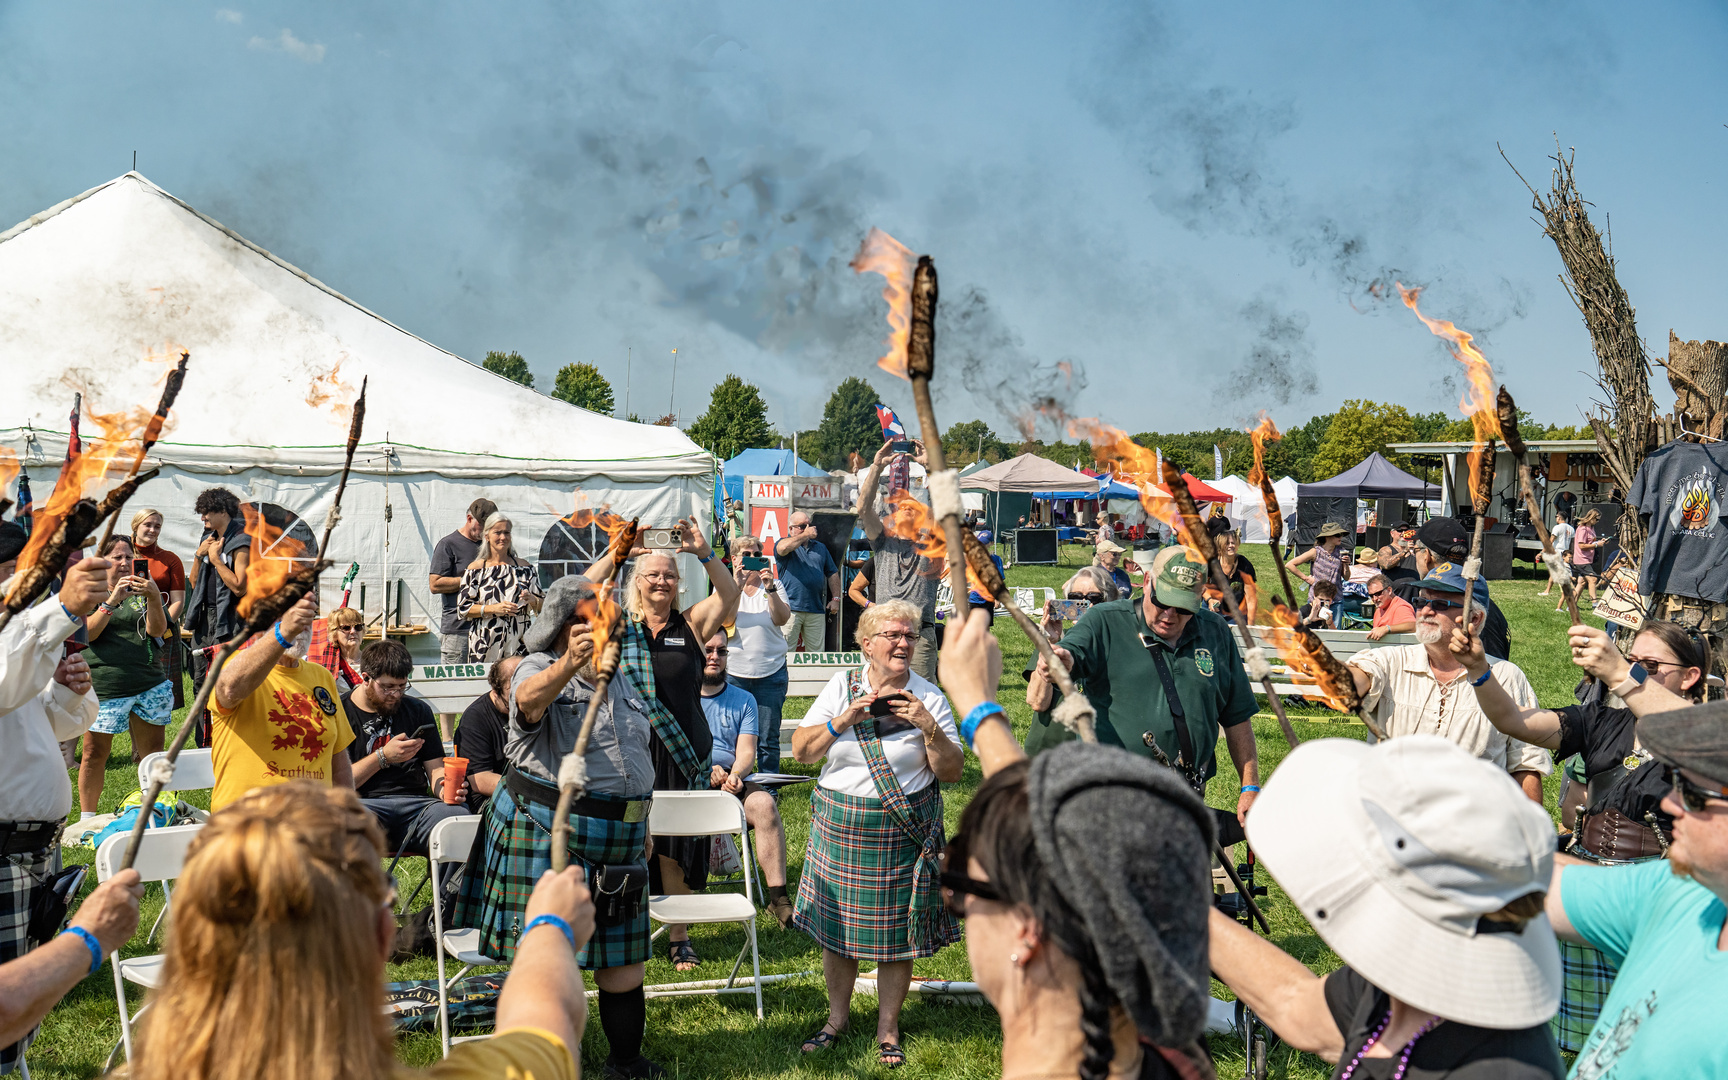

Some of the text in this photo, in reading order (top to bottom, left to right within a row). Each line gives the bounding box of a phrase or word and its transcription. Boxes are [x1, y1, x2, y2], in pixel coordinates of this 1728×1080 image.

[757, 483, 785, 498] ATM
[801, 484, 831, 498] ATM
[793, 653, 861, 664] APPLETON
[423, 664, 486, 679] WATERS
[262, 761, 324, 780] Scotland
